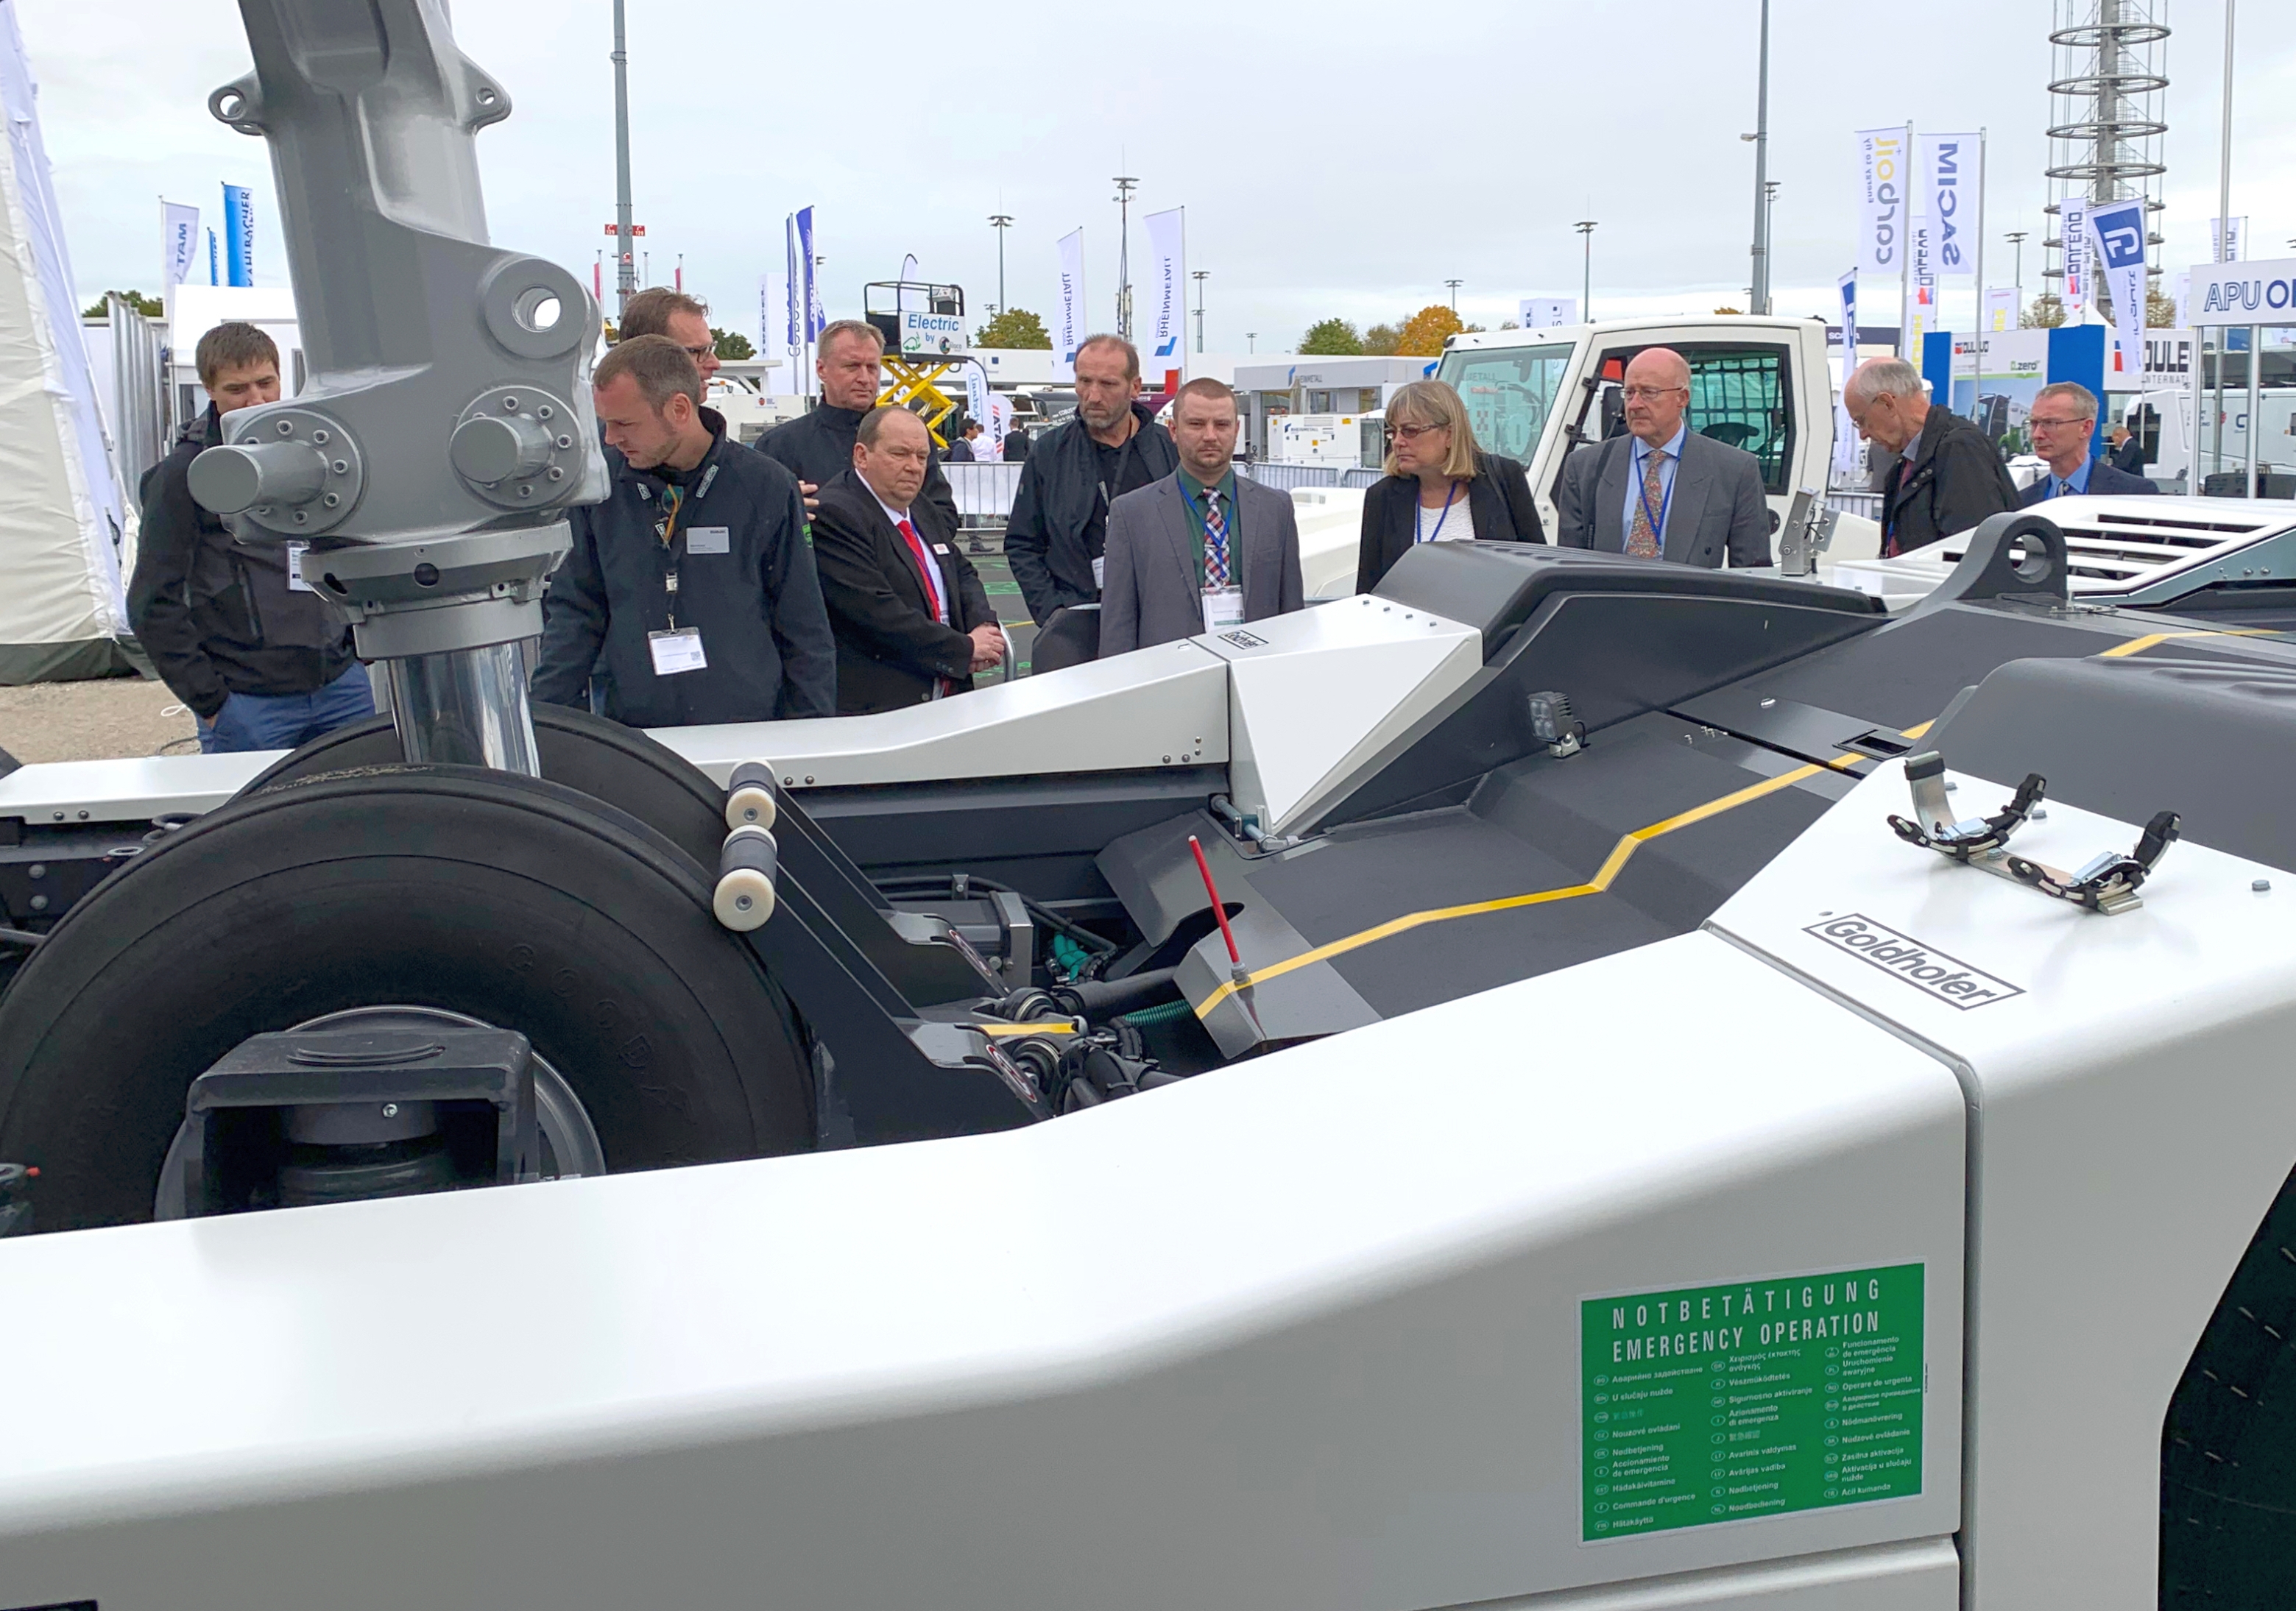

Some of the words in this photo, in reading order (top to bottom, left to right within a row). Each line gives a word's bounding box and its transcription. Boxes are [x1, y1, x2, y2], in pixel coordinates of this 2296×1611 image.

[2204, 280, 2261, 312] APU
[2267, 279, 2296, 309] O
[908, 314, 959, 331] Electric
[925, 332, 935, 344] by
[1824, 921, 1998, 1001] Goldhofer
[1613, 1278, 1879, 1329] NOTBETÄTIGUNG
[1614, 1326, 1743, 1362] EMERGENCY
[1761, 1311, 1879, 1345] OPERATION
[1843, 1336, 1899, 1348] Funcionamento
[1843, 1355, 1893, 1367] Uruchomienie
[1843, 1382, 1872, 1391] Operare
[1729, 1392, 1773, 1404] Sigurnosno
[1774, 1387, 1812, 1398] aktiviranje
[1729, 1405, 1778, 1417] Azionamento
[1738, 1415, 1778, 1426] emergenza
[1729, 1449, 1759, 1459] Avarinis
[1762, 1445, 1796, 1455] valdymas
[1870, 1446, 1904, 1457] aktivacija
[1612, 1455, 1670, 1468] Accionamiento
[1624, 1465, 1668, 1476] emergencia
[1842, 1463, 1877, 1473] Aktivacija
[1857, 1483, 1891, 1493] kumanda
[1612, 1498, 1656, 1510] Commande
[1658, 1494, 1695, 1504] d'urgence
[1729, 1499, 1786, 1512] Noodbediening
